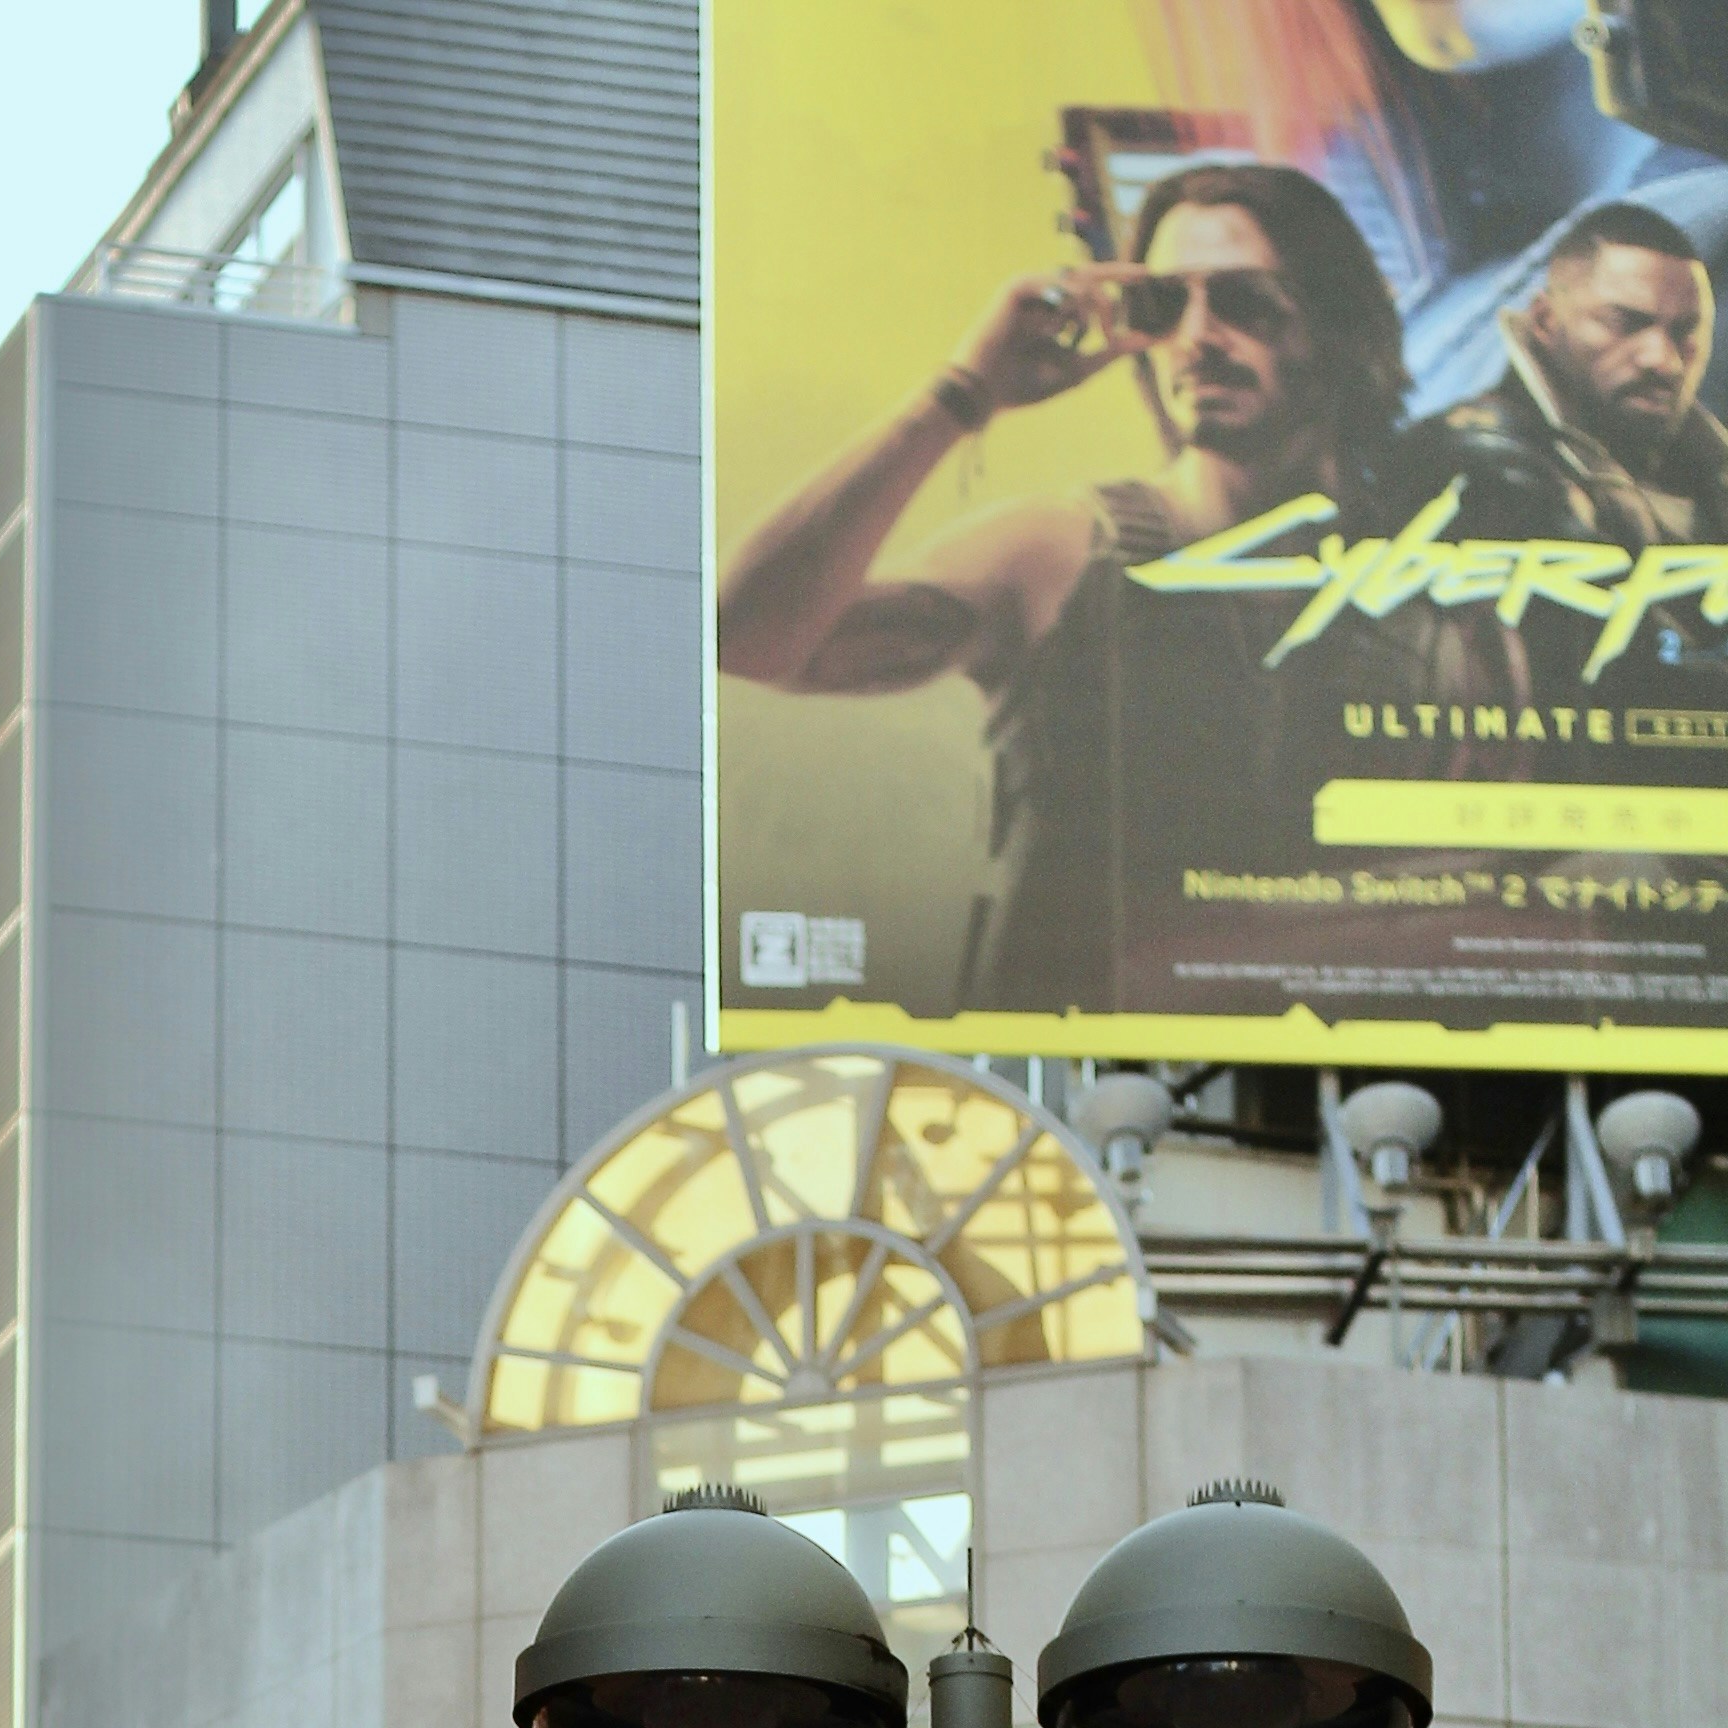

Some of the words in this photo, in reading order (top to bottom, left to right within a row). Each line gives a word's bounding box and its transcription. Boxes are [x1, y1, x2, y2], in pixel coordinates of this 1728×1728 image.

[1343, 702, 1614, 744] ULTIMATE
[1181, 868, 1344, 903] Nintendo
[1501, 873, 1528, 909] 2
